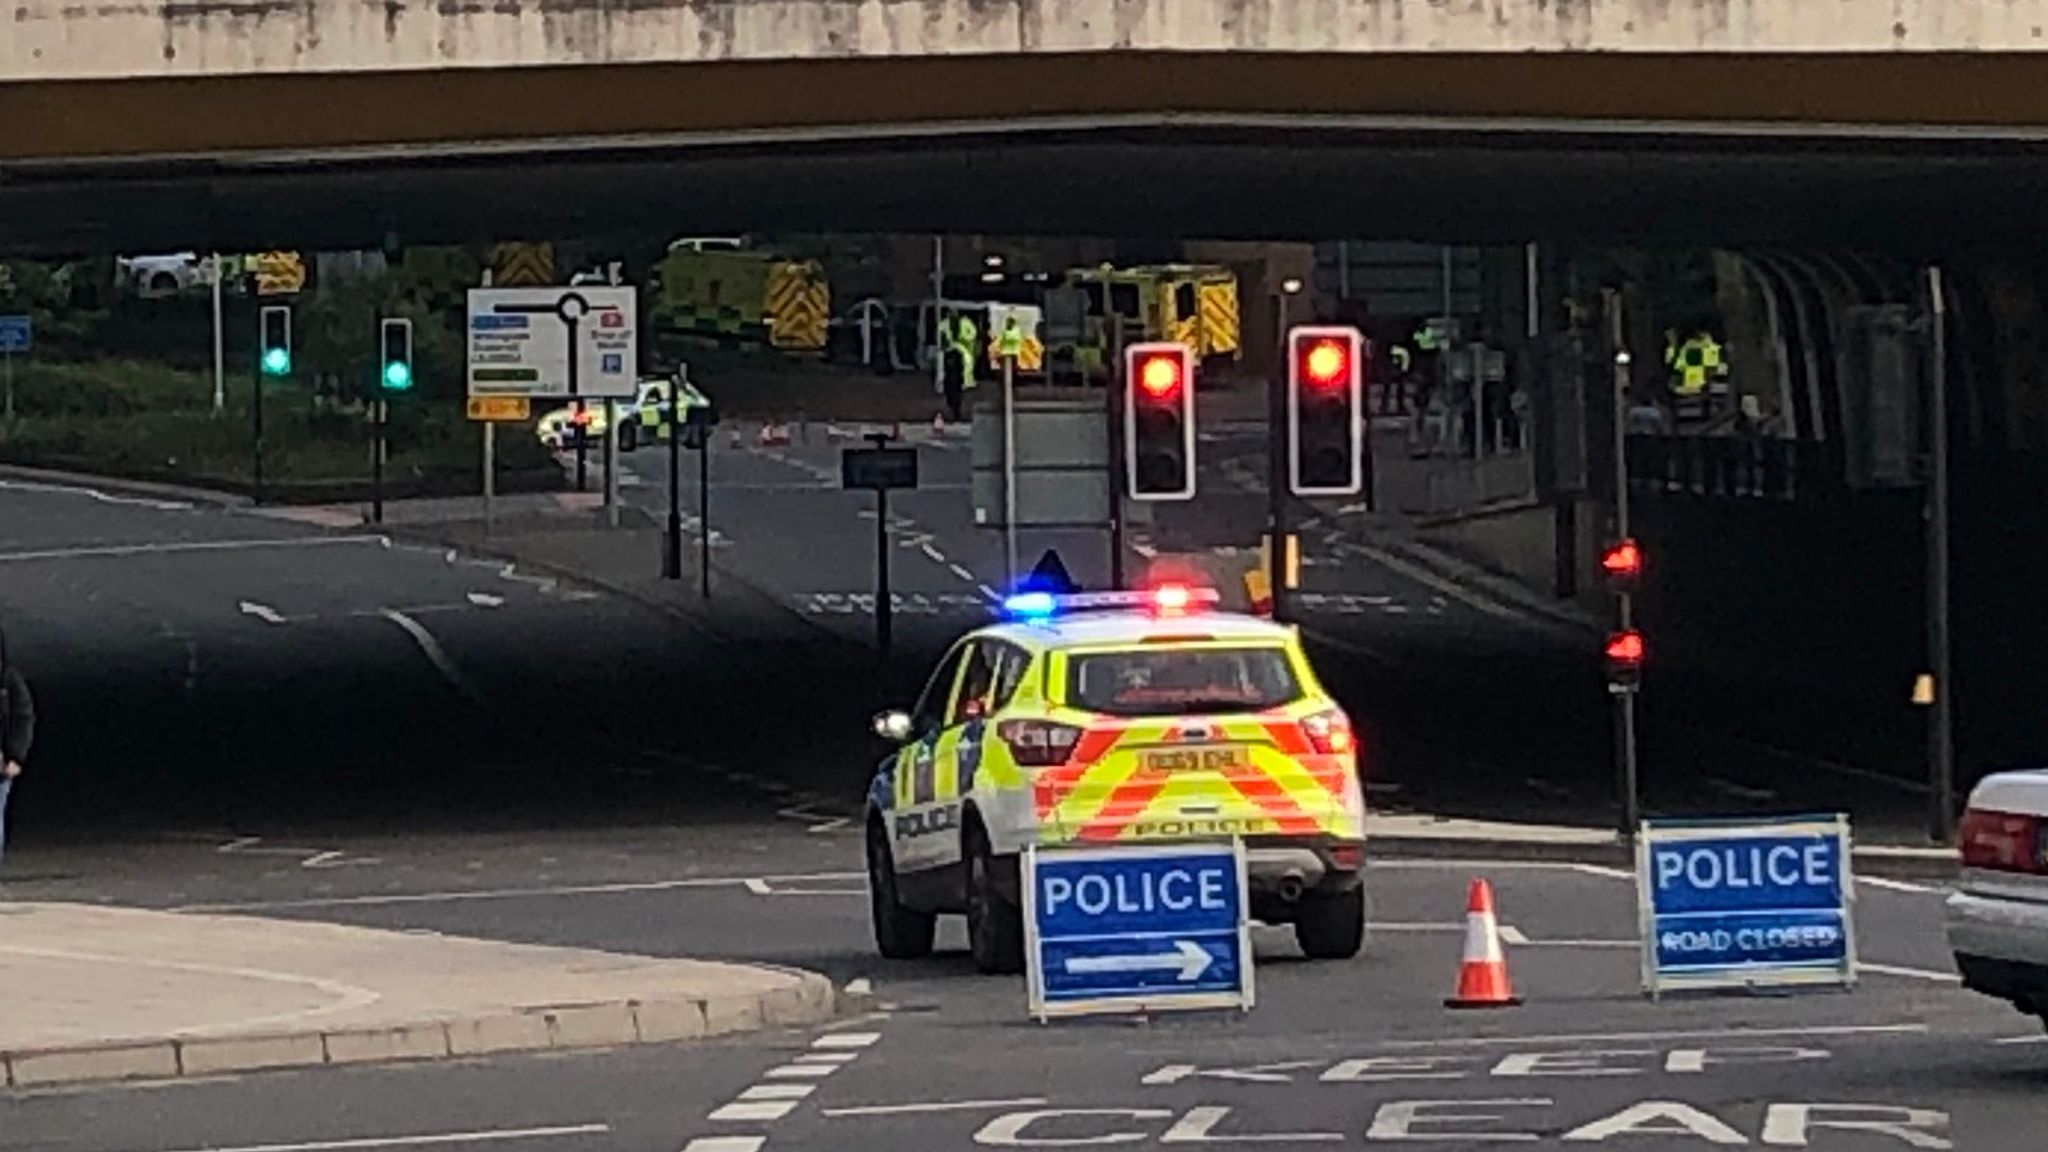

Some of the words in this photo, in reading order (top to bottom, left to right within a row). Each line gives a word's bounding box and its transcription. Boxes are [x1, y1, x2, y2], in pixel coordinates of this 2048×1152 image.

[895, 804, 959, 841] POLICE
[1135, 819, 1265, 836] POLICE
[1656, 844, 1834, 890] POLICE
[1043, 869, 1227, 916] POLICE
[1662, 929, 1732, 952] ROAD
[1736, 925, 1837, 951] CLOSED
[1141, 1046, 1832, 1085] KEEP
[972, 1099, 1952, 1149] CLEAR
